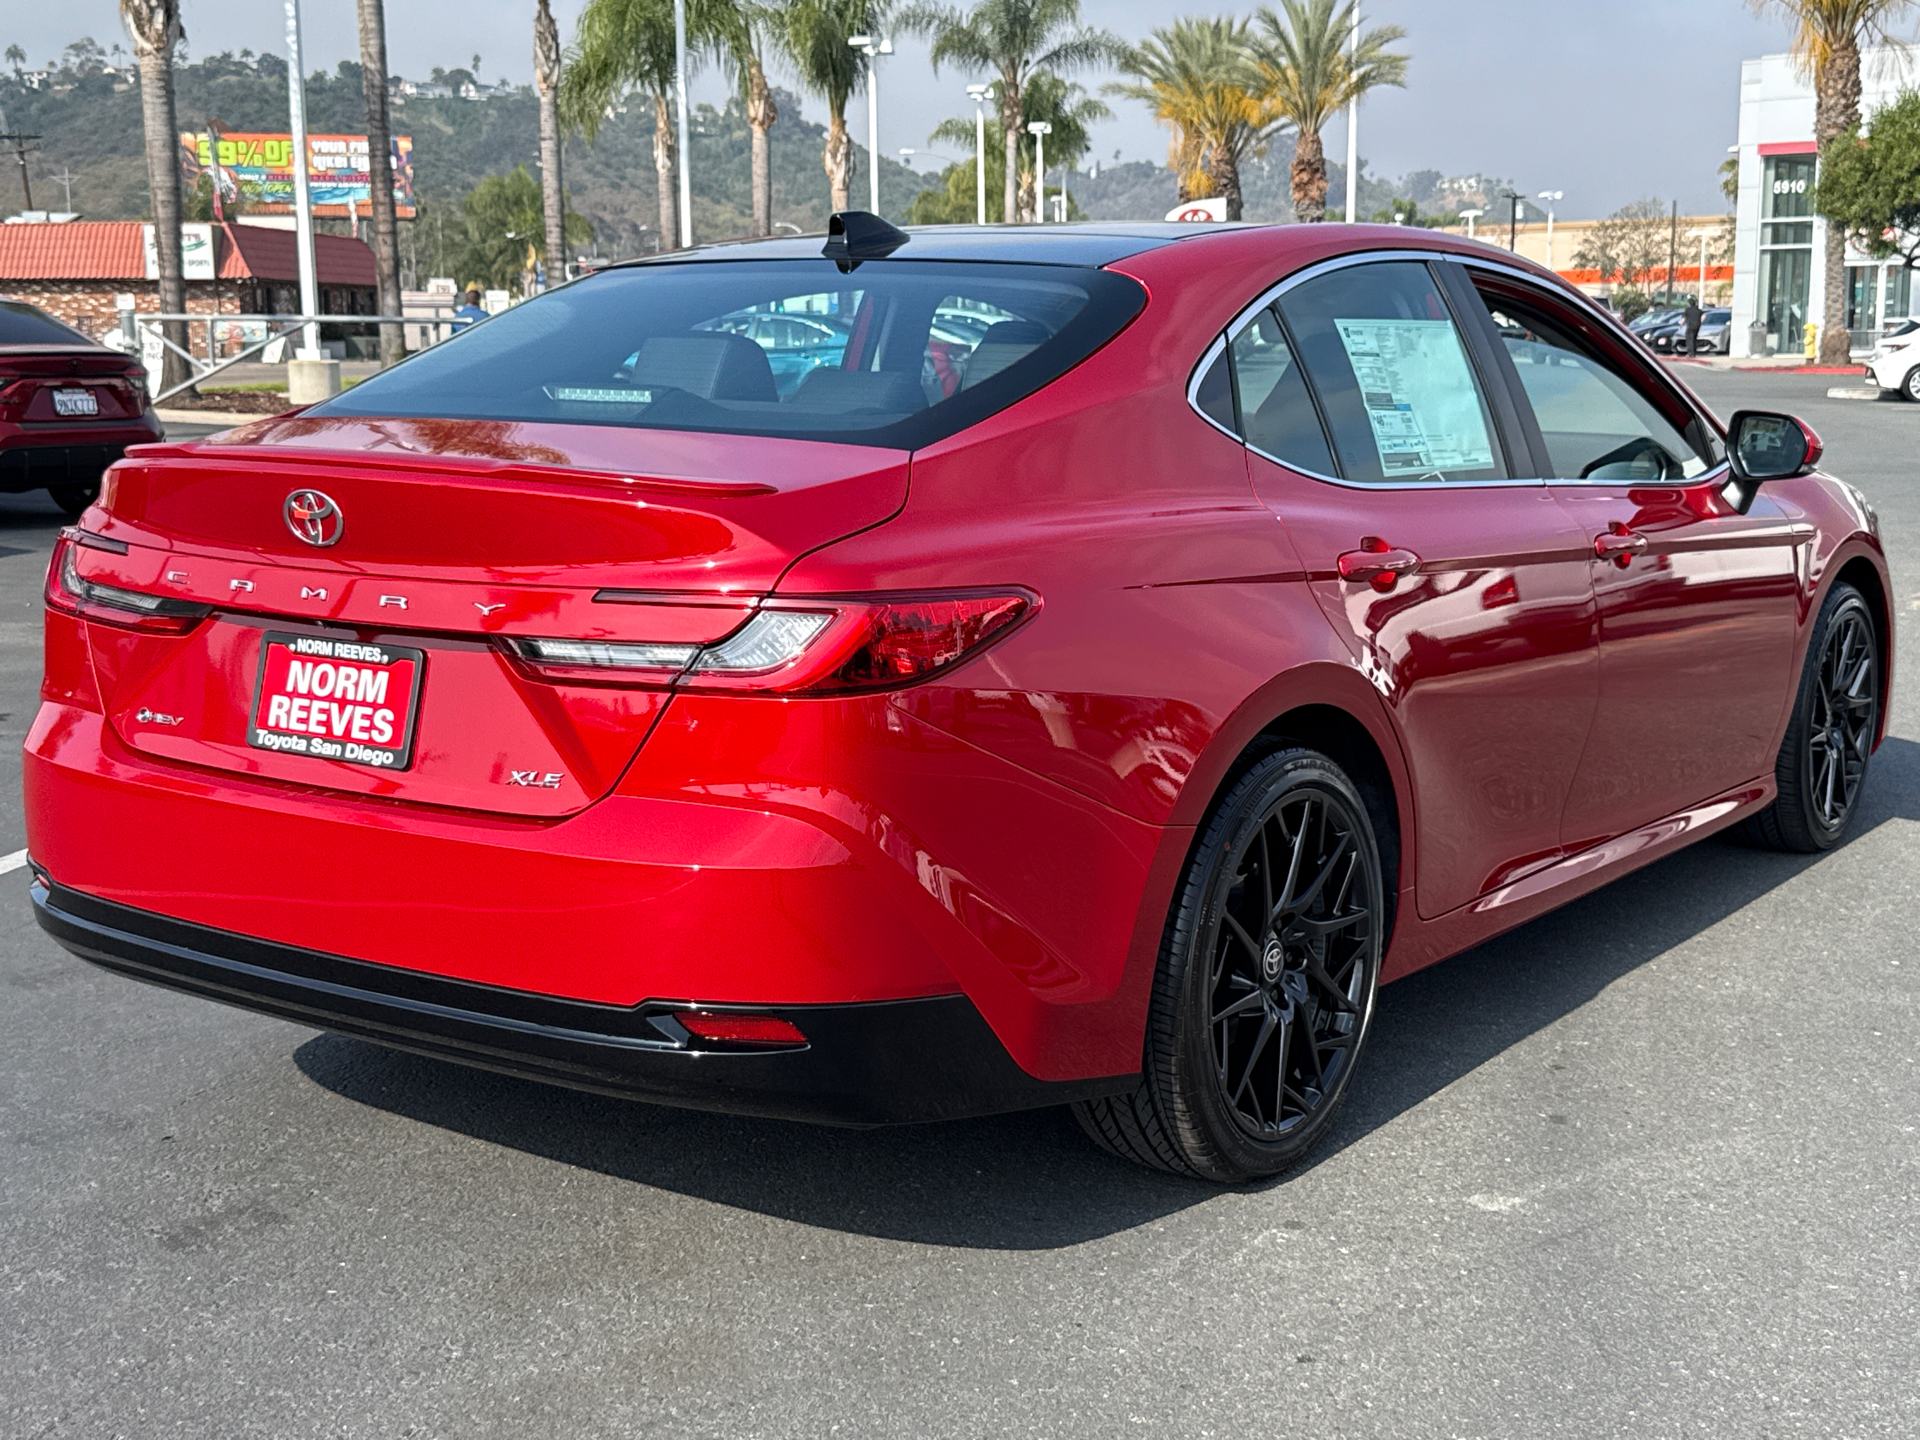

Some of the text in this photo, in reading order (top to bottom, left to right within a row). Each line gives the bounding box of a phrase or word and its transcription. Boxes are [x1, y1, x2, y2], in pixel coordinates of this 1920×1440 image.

[264, 140, 293, 167] OF
[311, 141, 347, 154] YOUR
[1773, 179, 1806, 194] 5910
[167, 570, 506, 616] CAMRY
[297, 638, 382, 662] NORM REEVES
[286, 660, 390, 704] NORM
[267, 694, 395, 743] REEVES
[256, 729, 394, 766] Toyota San Diego
[506, 770, 565, 789] XLE
